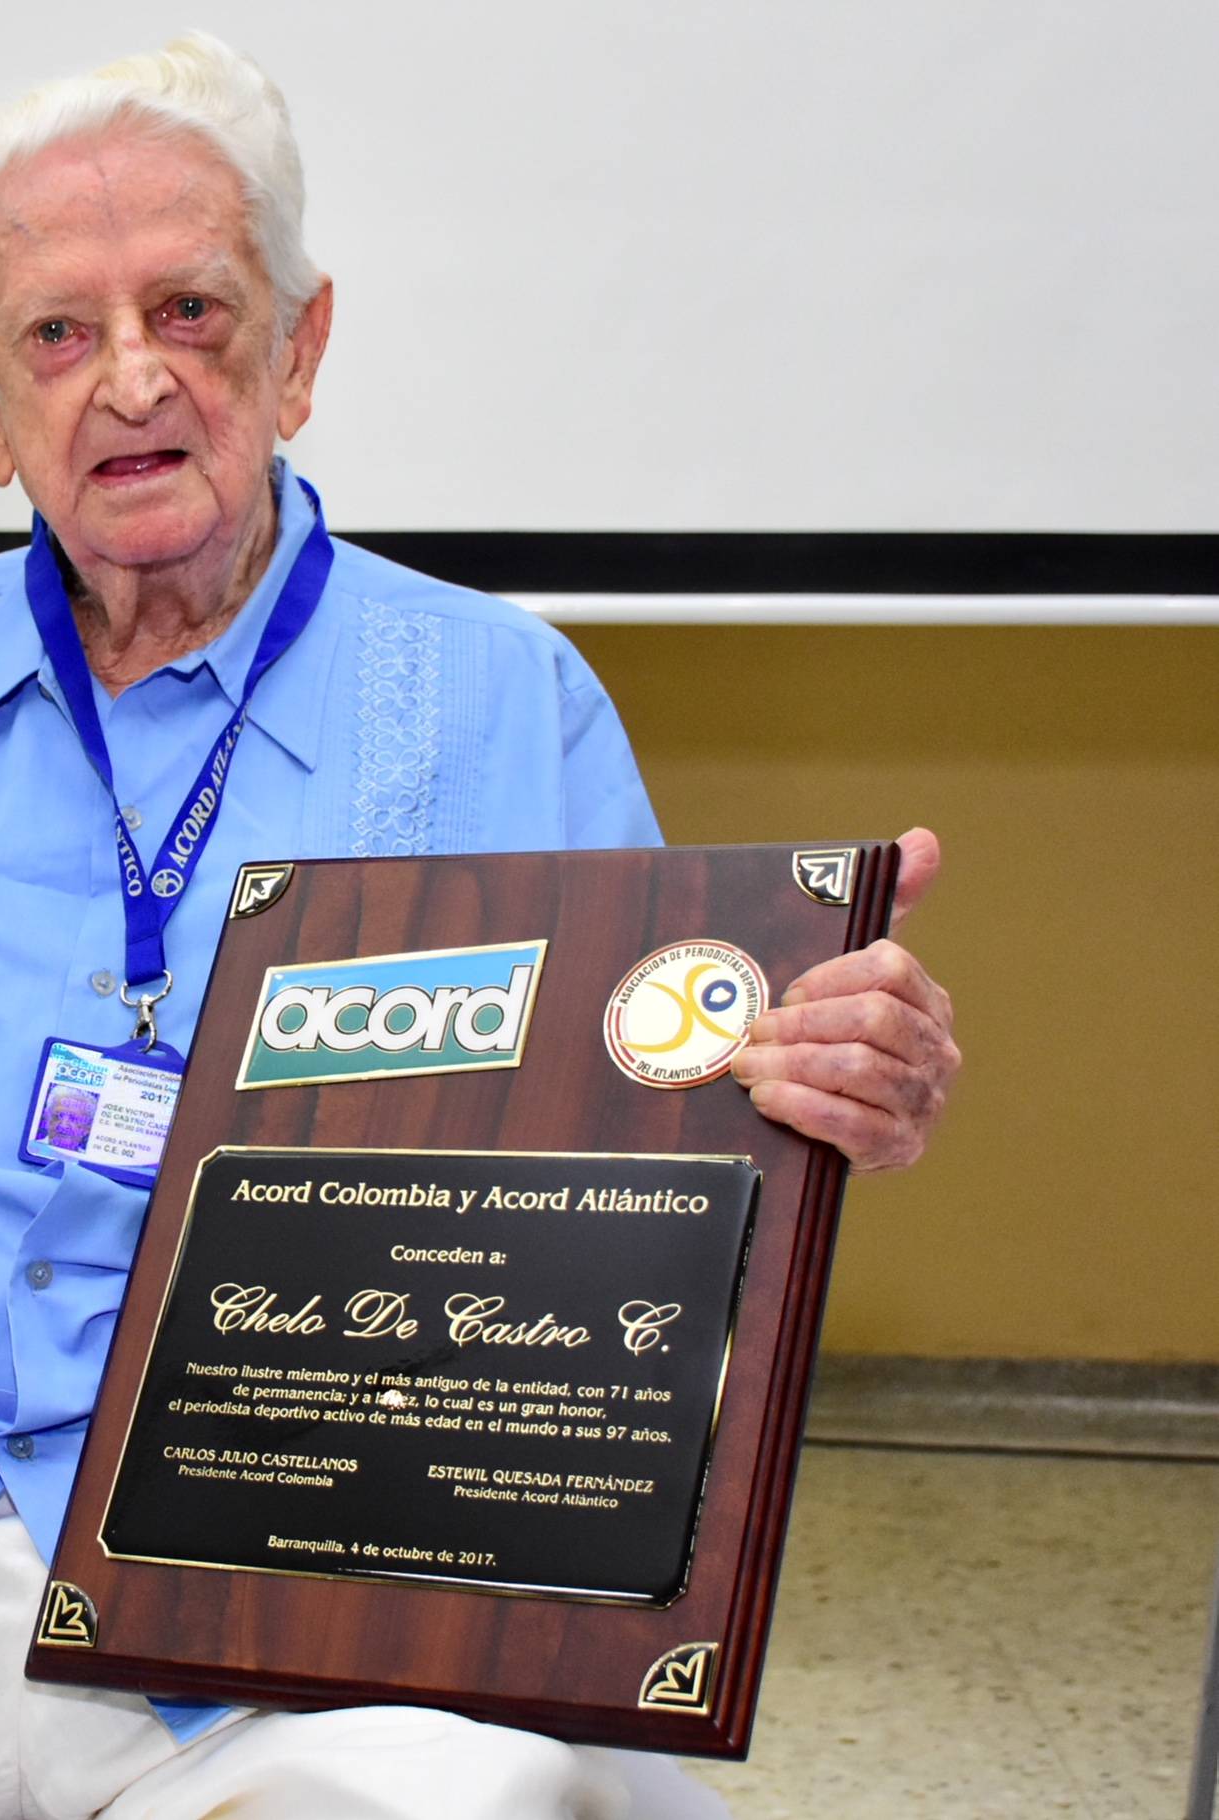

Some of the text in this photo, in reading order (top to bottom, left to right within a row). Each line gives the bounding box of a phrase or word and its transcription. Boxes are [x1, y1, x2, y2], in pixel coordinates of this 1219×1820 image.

[168, 787, 216, 868] ACORD
[619, 947, 758, 1026] ASOCIACION DE PERIODISTAS DEPORTIVOS
[259, 964, 534, 1052] acord
[636, 1060, 702, 1080] DEL ATLANTICO
[140, 1091, 171, 1104] 2017
[230, 1179, 709, 1214] Acord Colombia y Acord Atlántico
[390, 1244, 506, 1265] Conceden a:
[210, 1282, 679, 1356] Chelo De Castro C.
[186, 1362, 671, 1402] Nuestro ilustre miembro y el más antiguo de la entidad, con 71 años
[232, 1383, 250, 1397] de
[252, 1387, 347, 1403] permanencia;
[348, 1392, 359, 1406] y
[361, 1393, 371, 1404] a
[391, 1393, 420, 1408] ez,
[424, 1394, 439, 1408] lo
[442, 1396, 474, 1410] cual
[477, 1400, 494, 1412] es
[498, 1401, 517, 1413] un
[520, 1402, 554, 1417] gran
[558, 1402, 606, 1419] honor,
[168, 1398, 671, 1443] el periodista deportivo activo de más edad en el mundo a sus 97 años.
[163, 1446, 358, 1472] CARLOS JULIO CASTELLANOS
[178, 1464, 333, 1487] Presidente Acord Colombia
[427, 1464, 654, 1493] ESTEWIL QUESADA FERNÁNDEZ
[453, 1485, 619, 1508] Presidente Acord Atlántico
[267, 1535, 496, 1566] Barranquilla, 4 de octubre de 2017.
